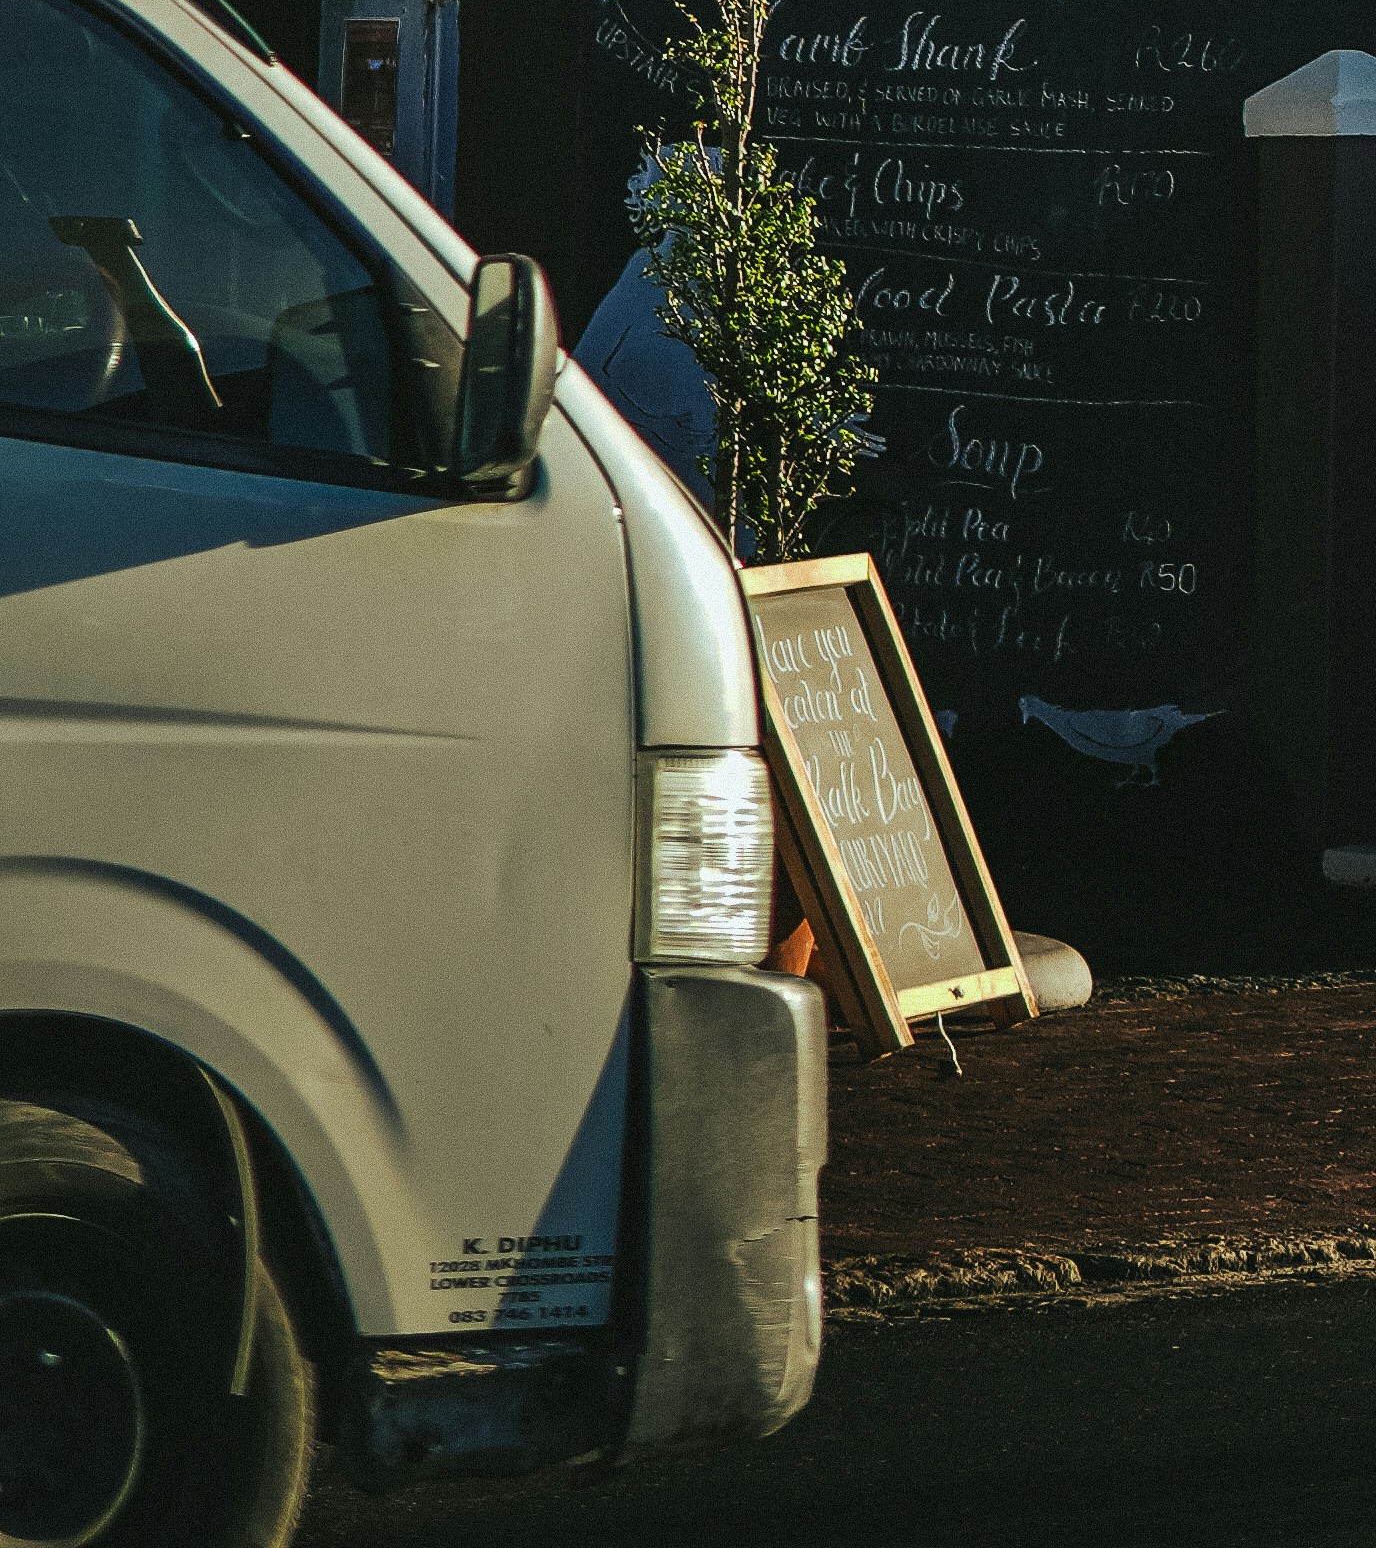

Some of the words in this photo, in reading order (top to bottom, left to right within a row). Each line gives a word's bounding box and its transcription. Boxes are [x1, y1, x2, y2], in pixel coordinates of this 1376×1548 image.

[884, 11, 1039, 82] Shank
[873, 157, 965, 221] Chips
[928, 404, 1044, 500] Soup
[1140, 561, 1196, 596] R50
[814, 625, 854, 693] you
[850, 667, 877, 722] at
[870, 737, 931, 840] Bay
[497, 1235, 583, 1254] DIPHU
[430, 1275, 491, 1290] LOWER
[450, 1309, 488, 1324] 083
